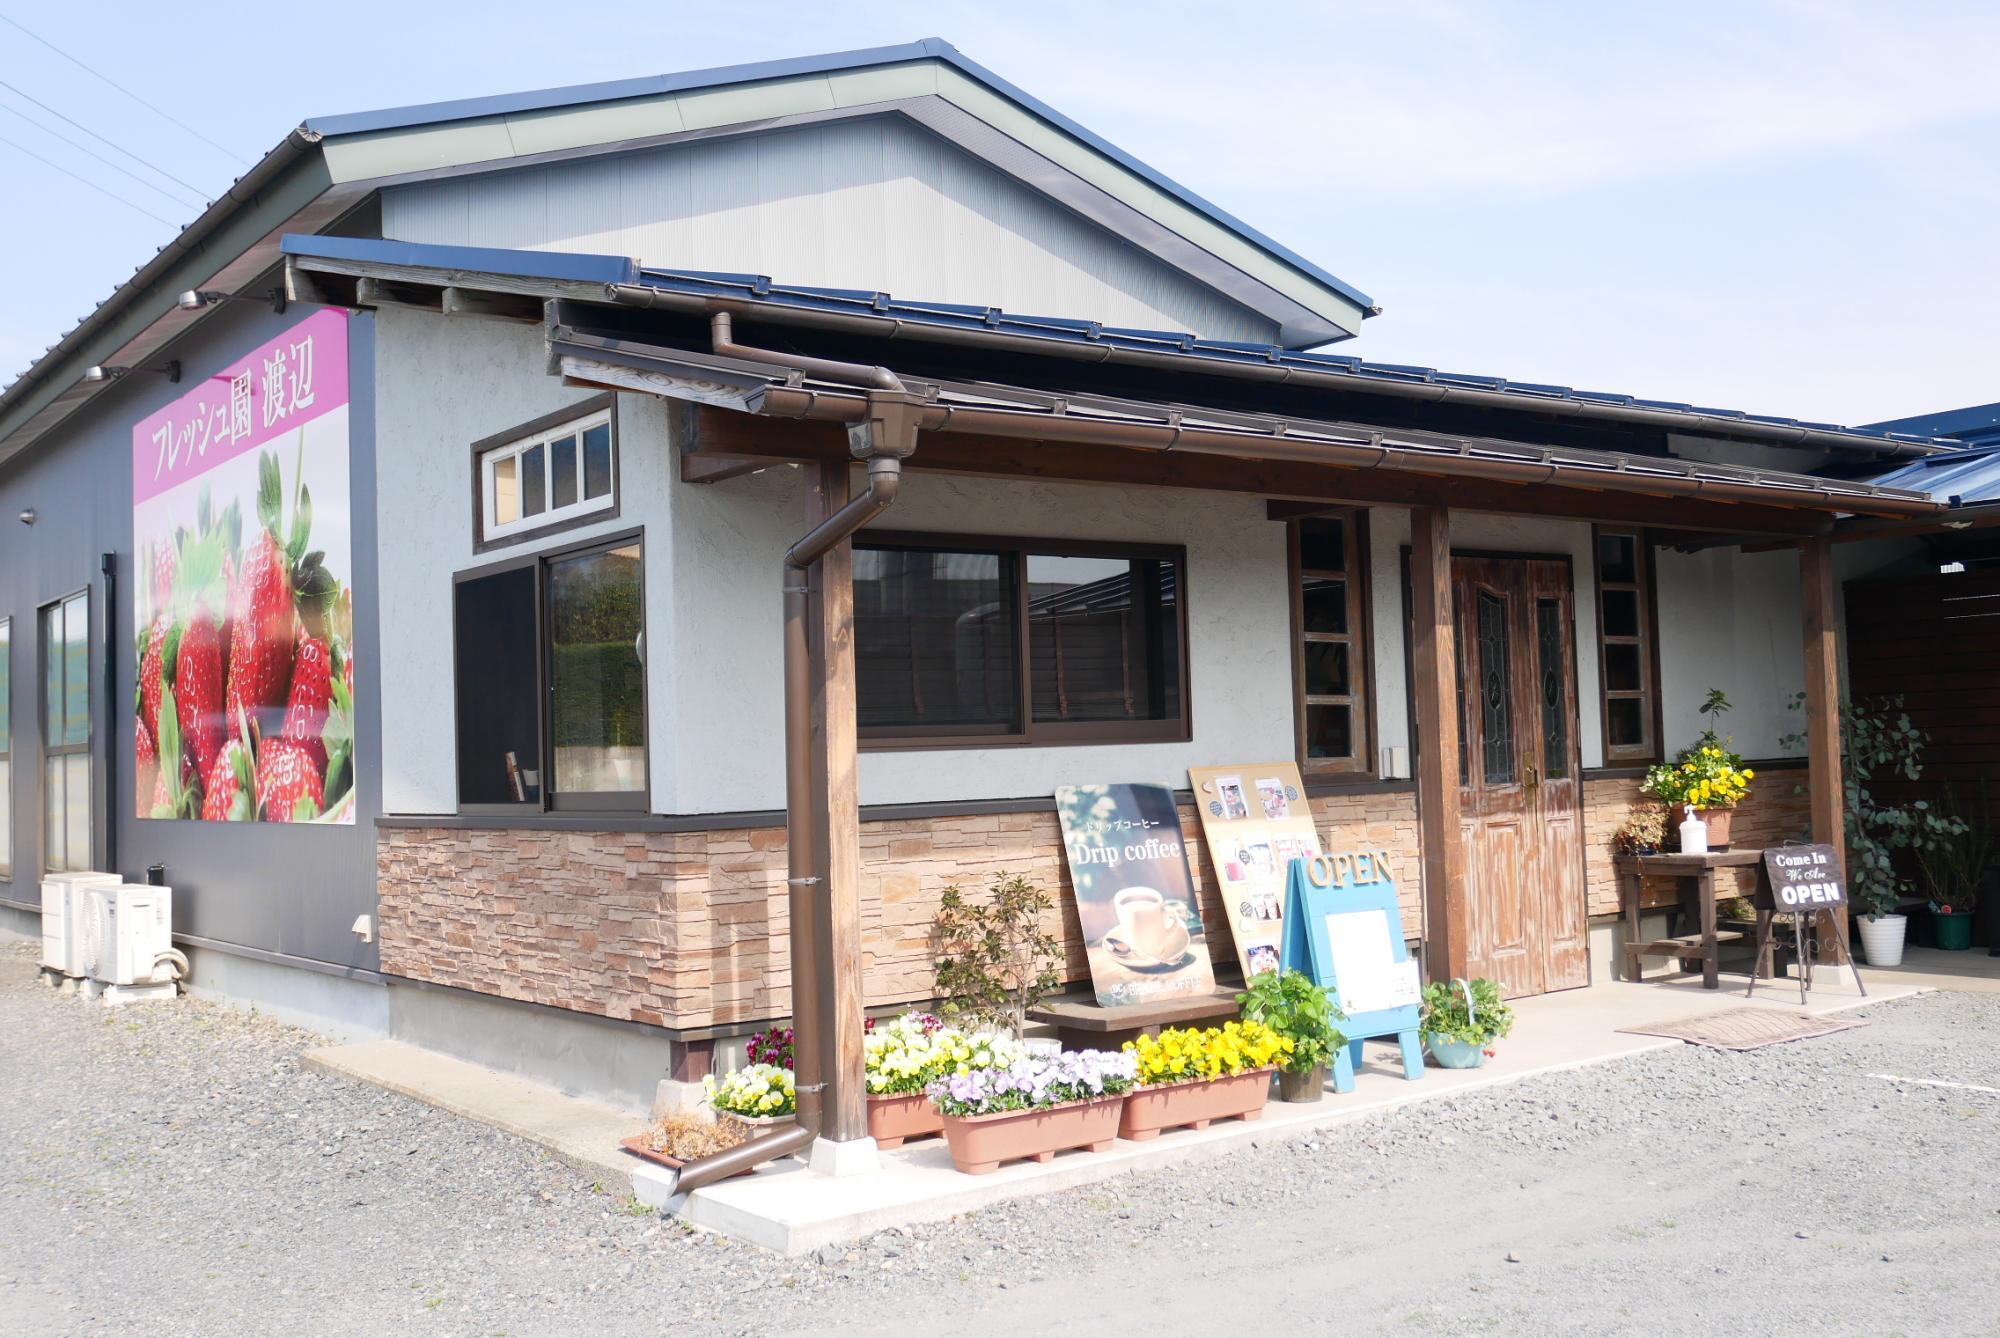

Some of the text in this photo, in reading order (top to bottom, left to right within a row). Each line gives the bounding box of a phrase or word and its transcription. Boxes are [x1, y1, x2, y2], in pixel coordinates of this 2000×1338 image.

[152, 334, 315, 481] フレッシュ園 渡辺
[1086, 818, 1160, 833] ドリップコーヒー
[1074, 838, 1181, 868] Drip coffee
[1775, 852, 1828, 867] Come In
[1308, 850, 1395, 889] OPEN
[1785, 867, 1826, 881] We Are
[1781, 882, 1840, 905] OPEN
